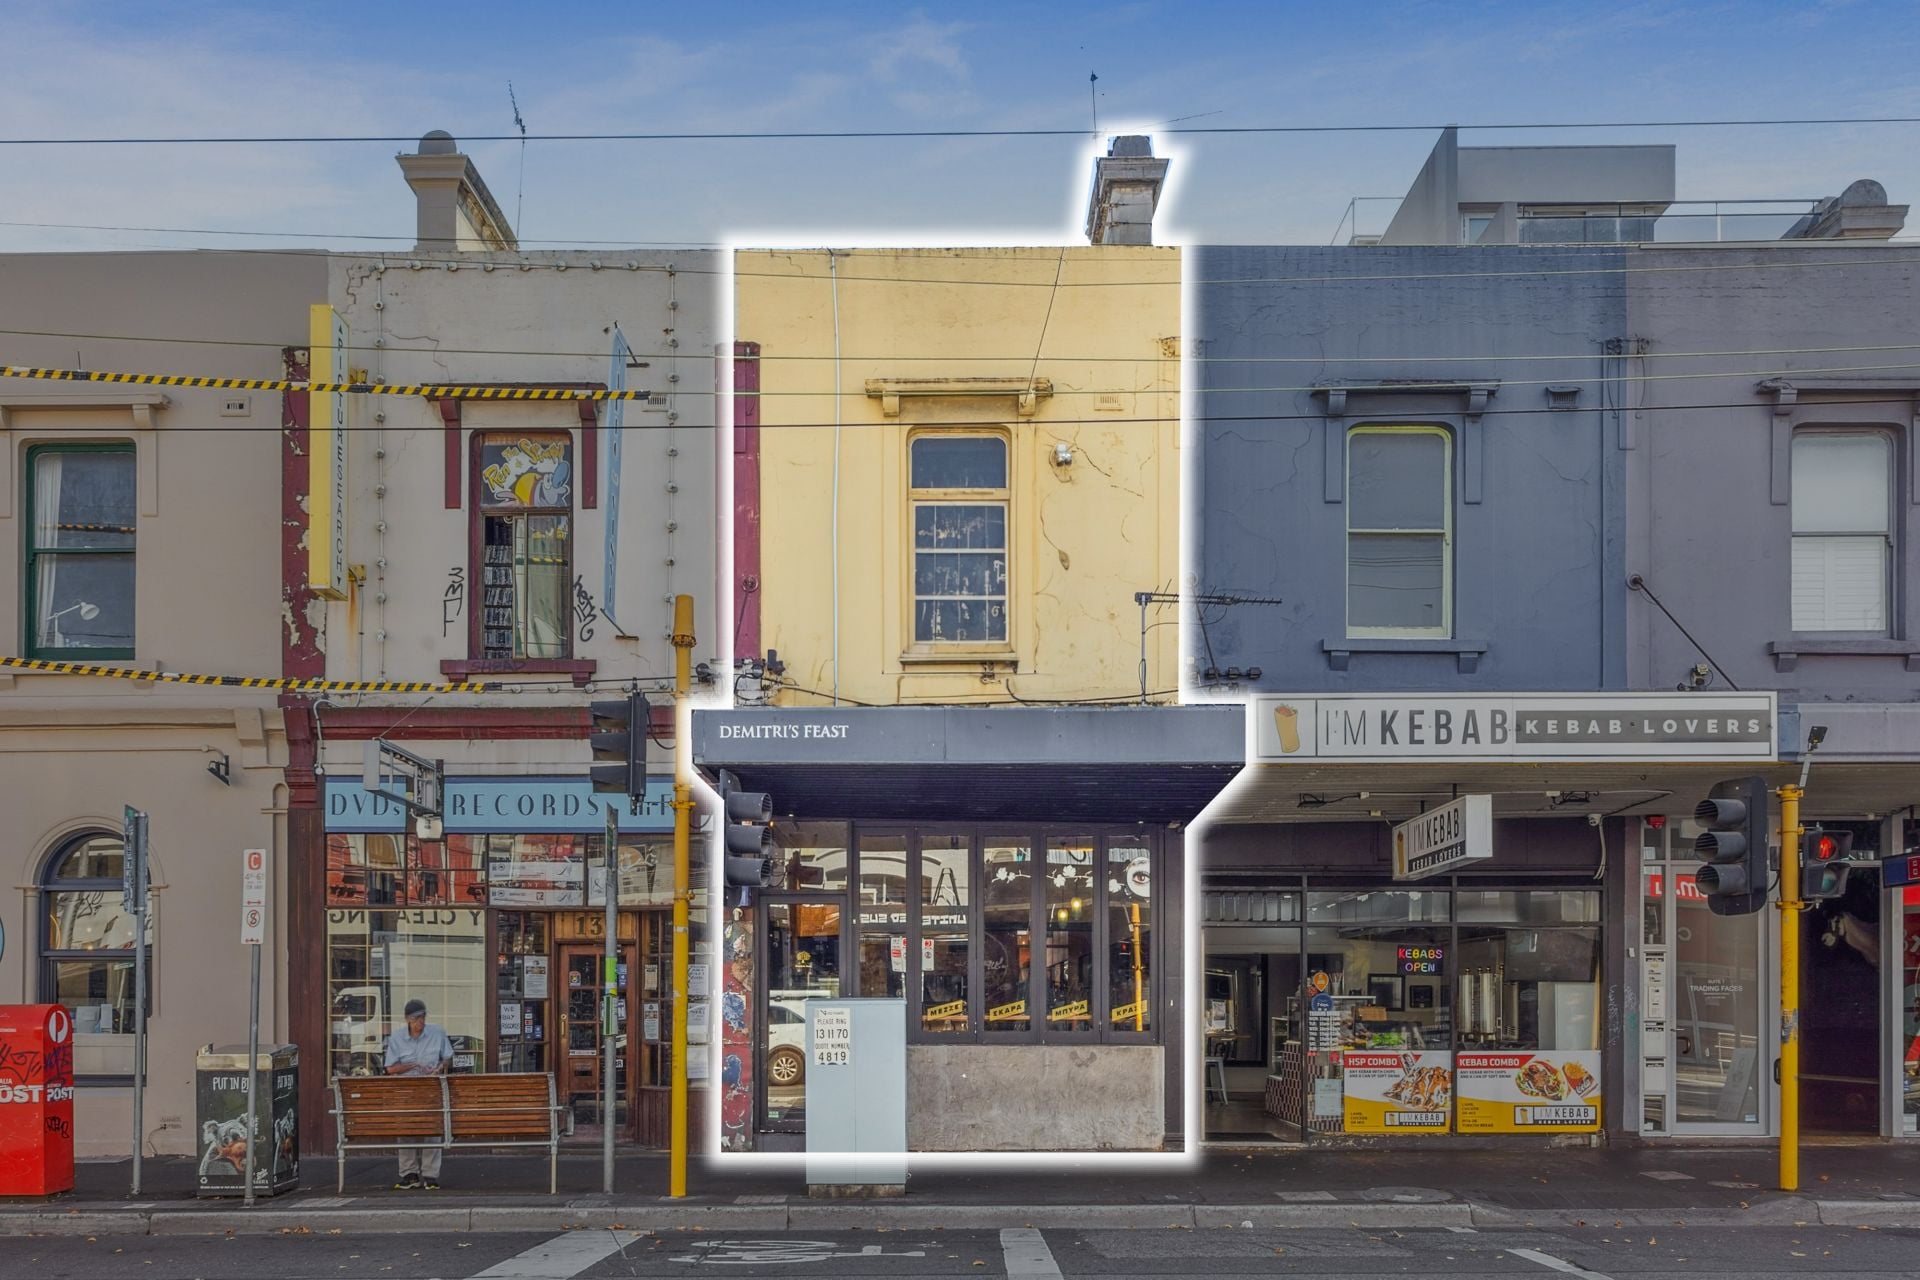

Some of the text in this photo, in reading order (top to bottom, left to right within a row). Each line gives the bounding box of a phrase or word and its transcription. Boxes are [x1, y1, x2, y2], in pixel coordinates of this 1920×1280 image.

[719, 725, 849, 739] DEMITRI'S FEAST
[1326, 709, 1760, 745] I'M KEBAB KEBAB LOVERS
[331, 794, 400, 815] DVDs
[452, 794, 599, 816] RECORDS
[1426, 808, 1460, 849] KEBAB
[1398, 947, 1443, 959] KEBABS
[1405, 962, 1436, 972] OPEN
[816, 1028, 849, 1039] 13 11 70
[1348, 1057, 1398, 1066] HSP COMBO
[1459, 1058, 1520, 1067] KEBAB COMBO
[212, 1076, 228, 1091] PUT
[230, 1076, 240, 1090] IN
[47, 1086, 74, 1102] POST
[1414, 1113, 1440, 1121] KEBAB
[1554, 1107, 1589, 1118] KEBAB
